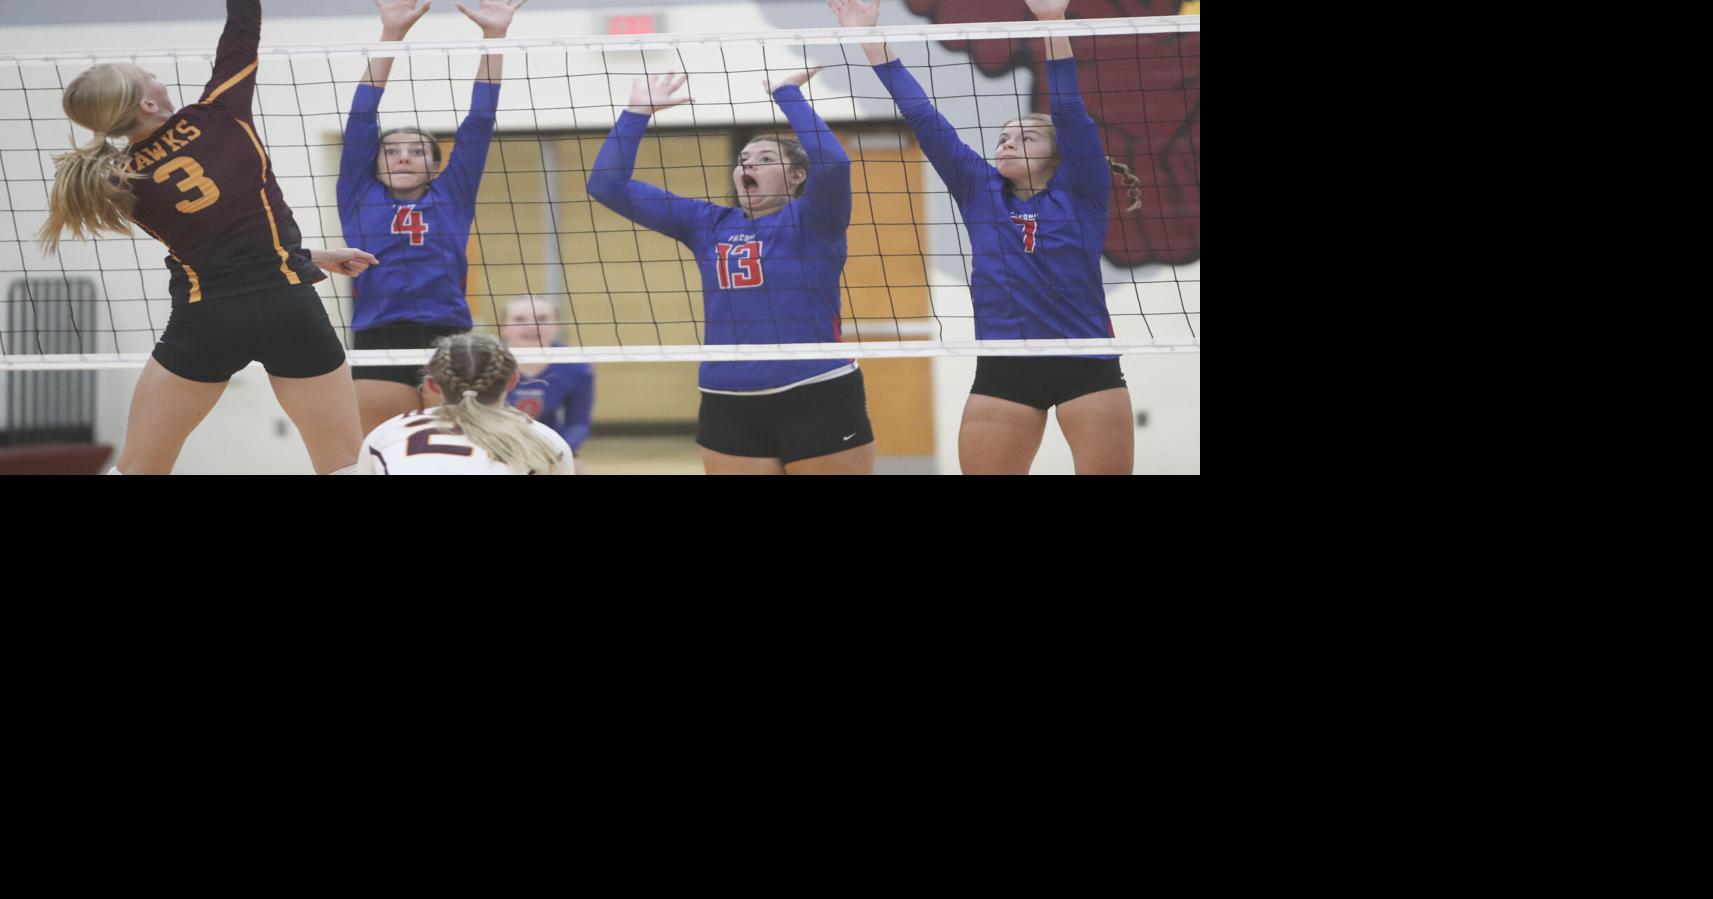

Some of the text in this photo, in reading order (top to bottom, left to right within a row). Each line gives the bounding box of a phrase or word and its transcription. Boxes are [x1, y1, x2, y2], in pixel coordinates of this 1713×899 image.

[153, 156, 221, 213] 3
[390, 205, 429, 246] 4
[1010, 216, 1038, 253] 7
[715, 240, 764, 290] 13
